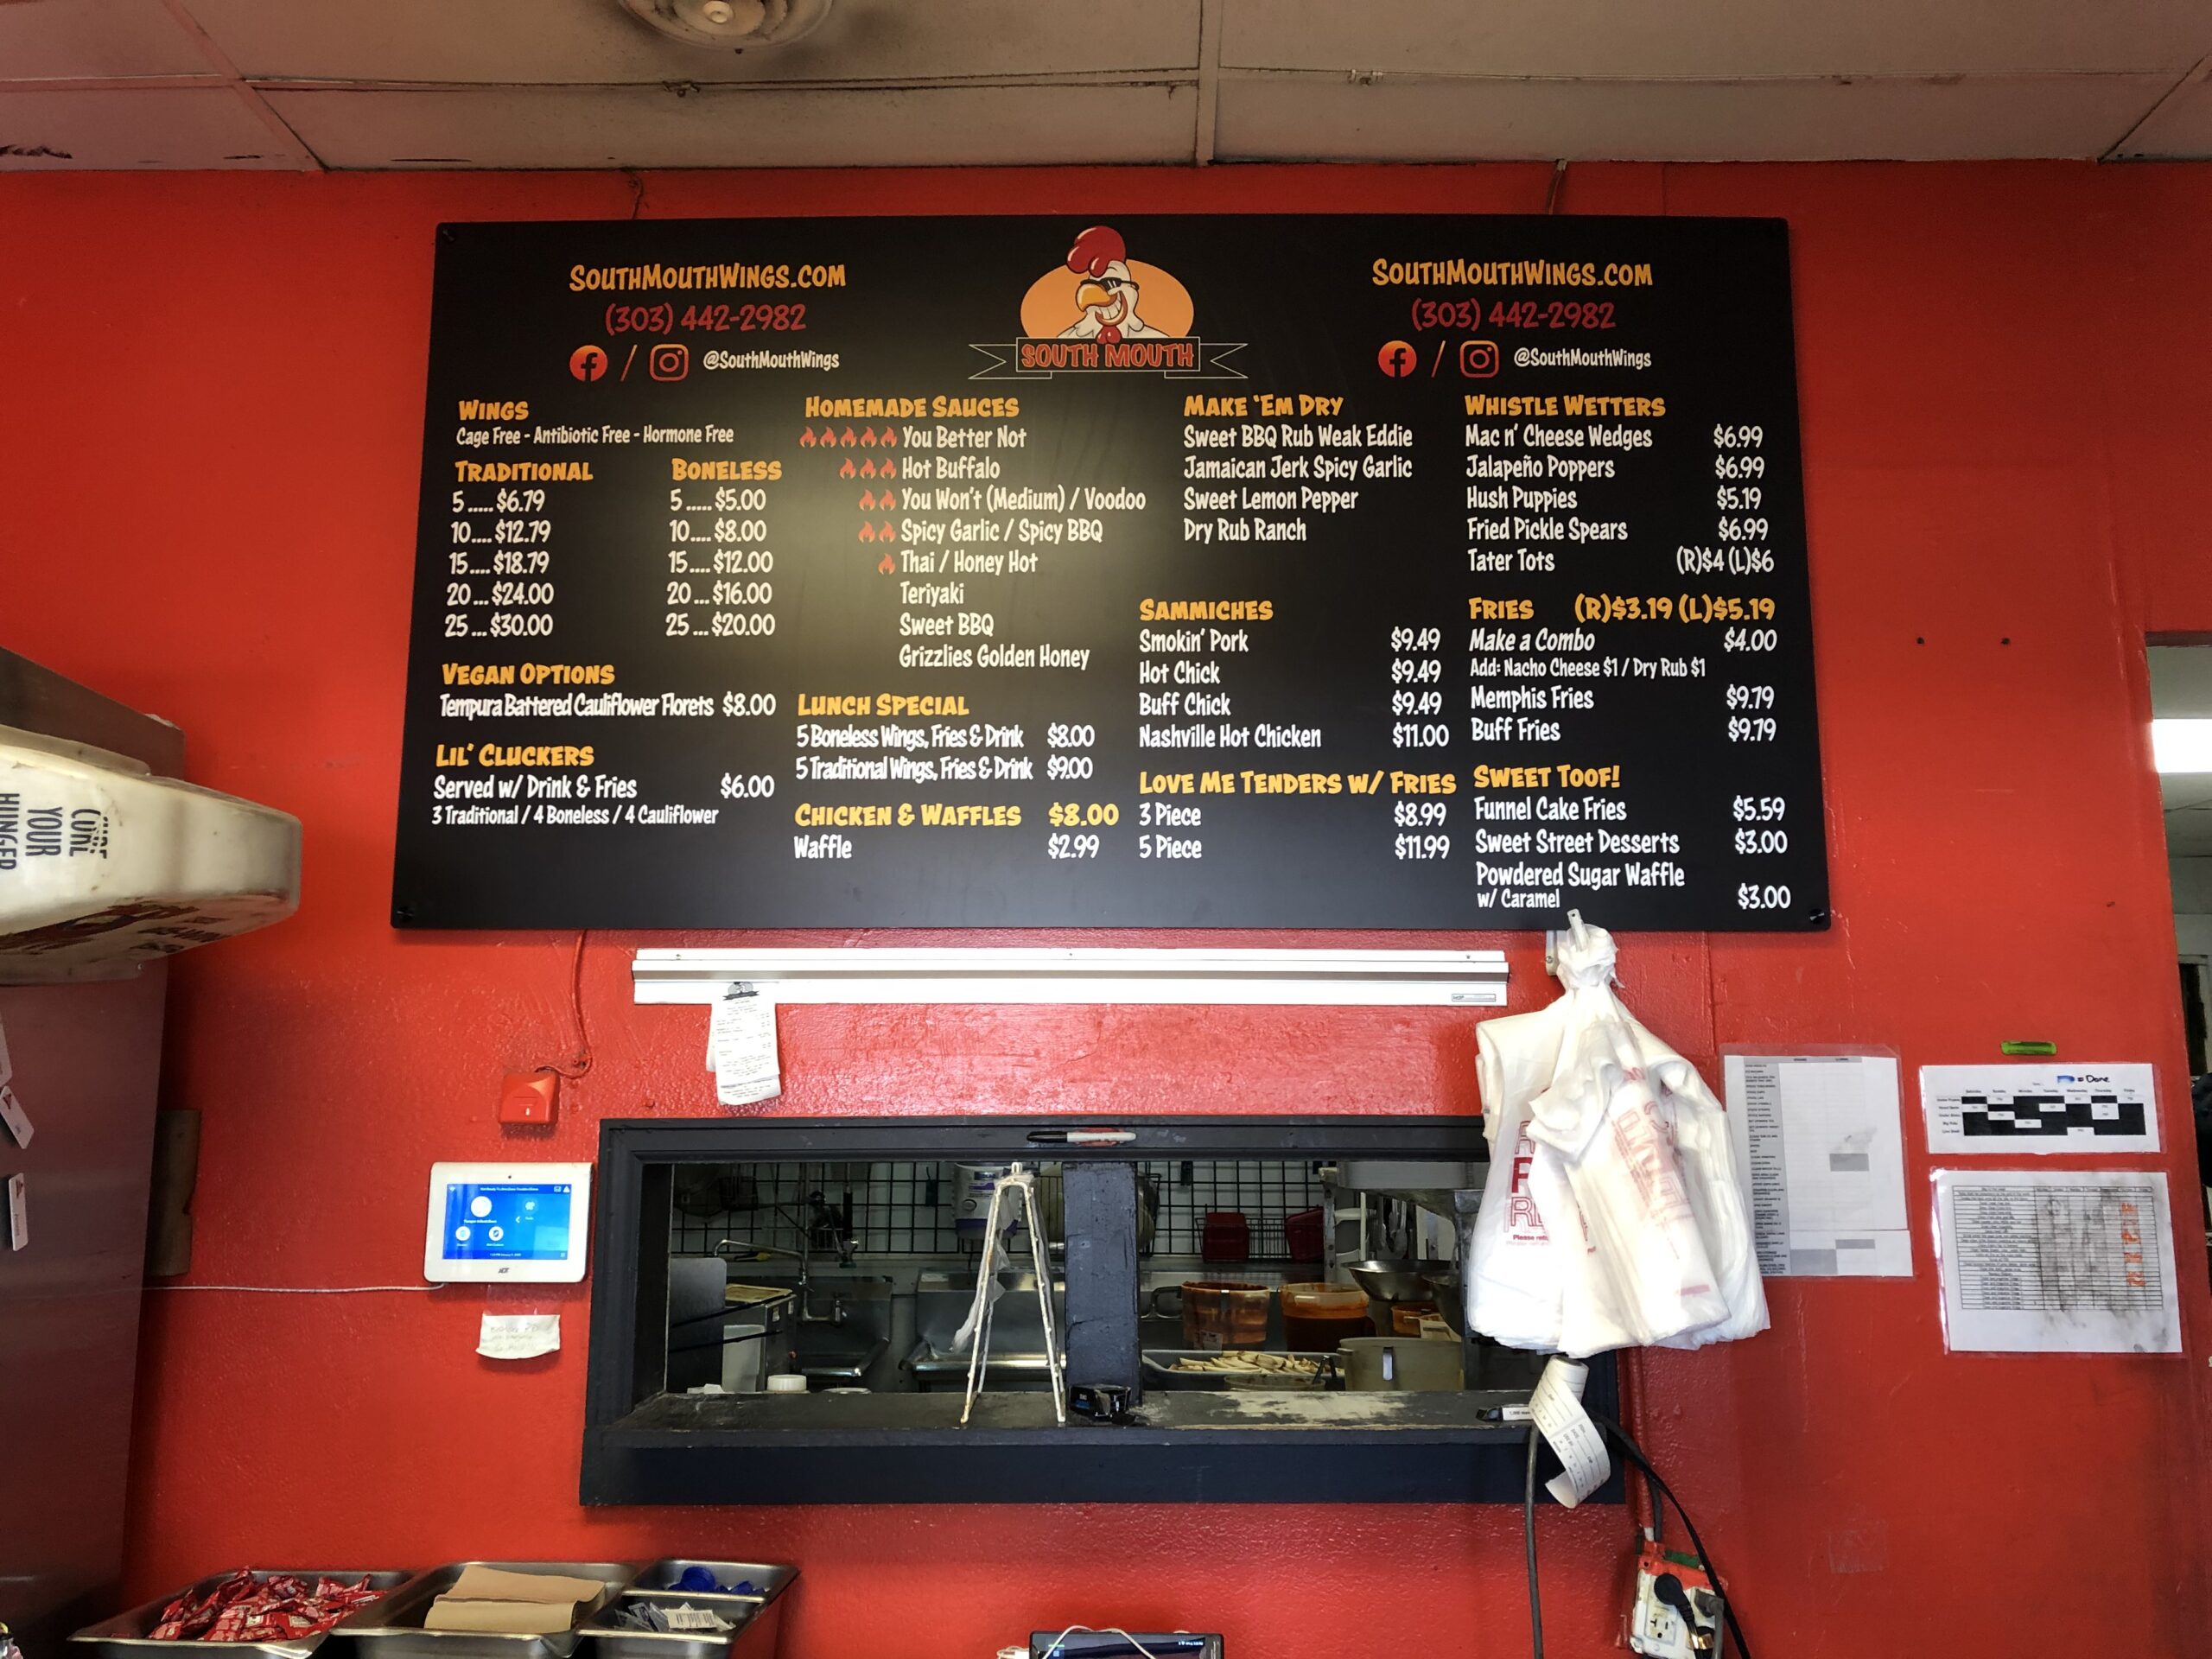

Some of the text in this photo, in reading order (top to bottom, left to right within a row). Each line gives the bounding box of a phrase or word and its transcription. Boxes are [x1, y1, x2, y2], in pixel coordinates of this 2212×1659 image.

[606, 302, 806, 335] (303) 442-2982
[1412, 298, 1616, 331] (303) 442-2982
[703, 350, 839, 371] @SouthMouthWings
[1021, 343, 1194, 367] SOUTH MOUTH
[1514, 347, 1651, 370] @SouthMouthWings
[456, 424, 734, 448] Cage Free Antibiotic Free Hormone Free
[903, 425, 1027, 448] You Better Not
[1184, 424, 1412, 448] Sweet BBQ Rub Weak Eddie
[1466, 424, 1763, 451] Mac Cheese Wedges $6.99
[903, 456, 1000, 479] Hot Buffalo
[1184, 455, 1412, 481] Jamaican Jerk Spicy Garlic
[1466, 454, 1764, 481] Jalapeño Poppers $6.99
[902, 485, 1146, 512] You Won't (Medium) Voodoo
[1184, 486, 1358, 512] Sweet Lemon Pepper
[1467, 485, 1761, 512] Hush Puppies $5.19
[901, 518, 1103, 545] Spicy Garlic Spicy BBQ
[1184, 518, 1306, 543] Dry Rub Ranch
[1467, 516, 1768, 543] Fried Pickle Spears $6.99
[901, 550, 1038, 575] Thai Honey Hot
[1468, 548, 1554, 571] Tater Tots
[900, 581, 963, 607] Teriyaki
[899, 613, 994, 637] Sweet BBQ
[1140, 626, 1440, 652] Smokin' Pork $9.49
[1469, 626, 1777, 652] Make Combo $4.00
[899, 644, 1090, 671] Grizzlies Golden Honey
[1504, 658, 1688, 679] Nacho Cheese Dry Rub
[1140, 658, 1441, 684] Hot Chick $9.49
[440, 691, 776, 721] Tempura Battered Cauliflower Florets $8.00
[1140, 690, 1441, 715] Buff Chick $9.49
[1471, 684, 1774, 713] Memphis Fries $9.79
[810, 722, 1095, 752] Boneless Wings, Fries Drink $8.00
[1140, 722, 1449, 747] Nashville Hot Chicken $11.00
[1471, 716, 1776, 741] Buff Fries $9.79
[434, 772, 774, 799] Served Drink Fries $6.00
[1474, 795, 1785, 821] Funnel Cake Fries $5.59
[25, 806, 63, 856] YOUR
[1476, 828, 1787, 854] Sweet Street Desserts $3.00
[794, 833, 1099, 859] Waffle $2.99
[1156, 833, 1450, 860] Piece $11.99
[1477, 861, 1685, 890] Powdered Sugar Waffle
[1501, 886, 1790, 909] Caramel $3.00
